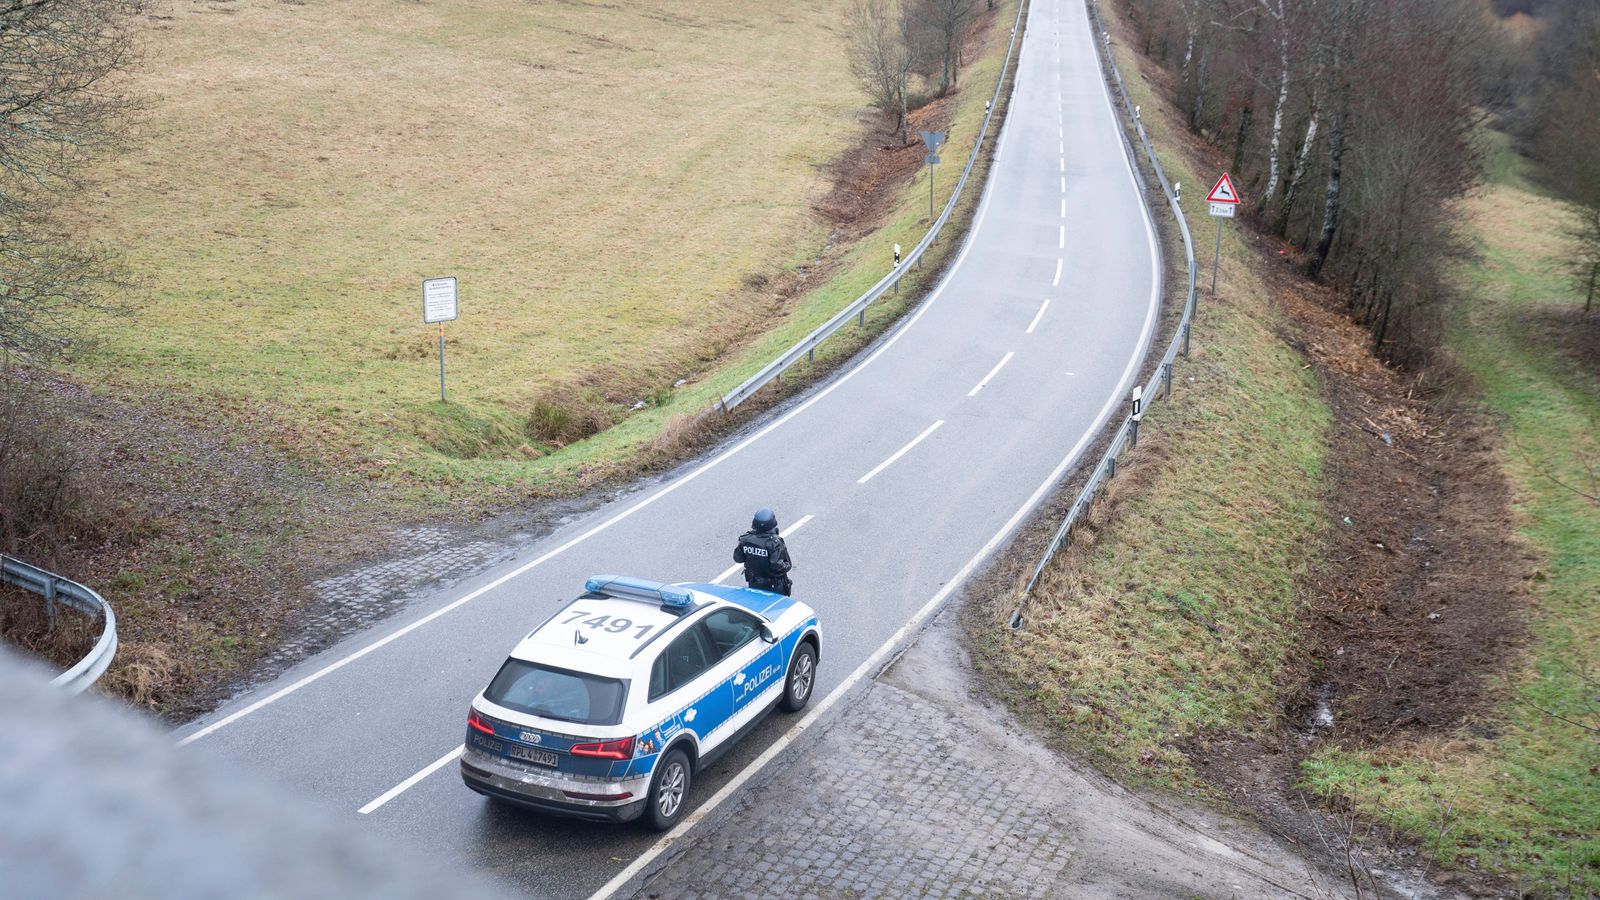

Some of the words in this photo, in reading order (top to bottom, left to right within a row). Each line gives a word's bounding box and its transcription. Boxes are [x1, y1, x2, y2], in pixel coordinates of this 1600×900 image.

[743, 546, 768, 557] POLIZEI
[561, 611, 655, 640] 7491
[744, 664, 772, 696] POLIZEI
[474, 735, 503, 752] POLIZEI
[537, 751, 557, 765] 7491
